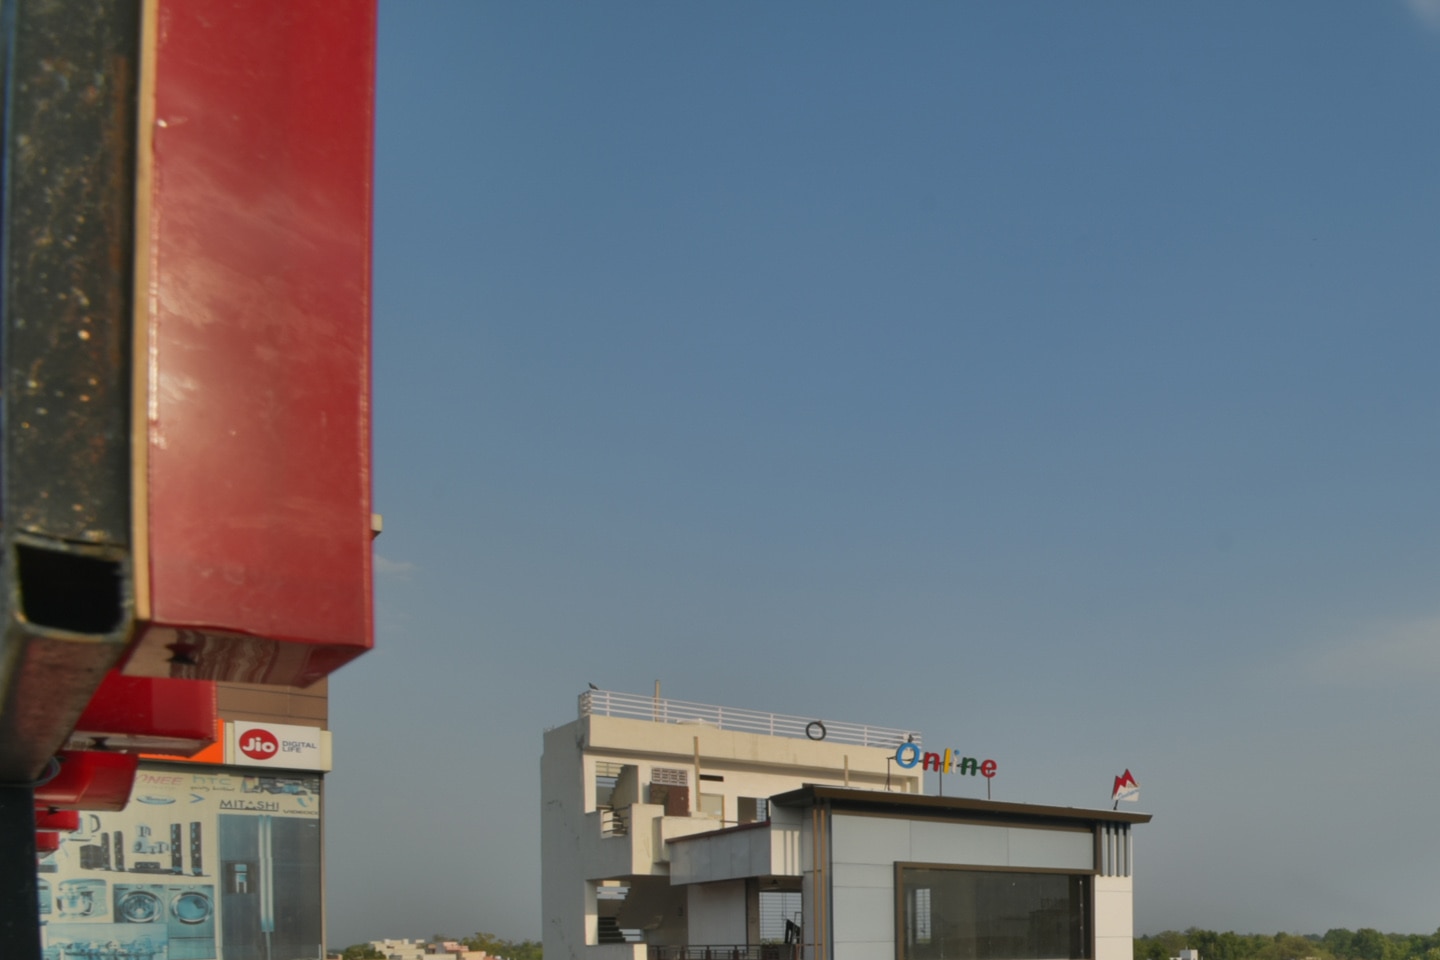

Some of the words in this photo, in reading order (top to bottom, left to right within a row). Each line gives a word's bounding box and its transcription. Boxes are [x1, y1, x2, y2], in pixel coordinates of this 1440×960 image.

[242, 737, 276, 753] Jio
[281, 740, 317, 750] DIGITAL
[895, 741, 998, 778] Online
